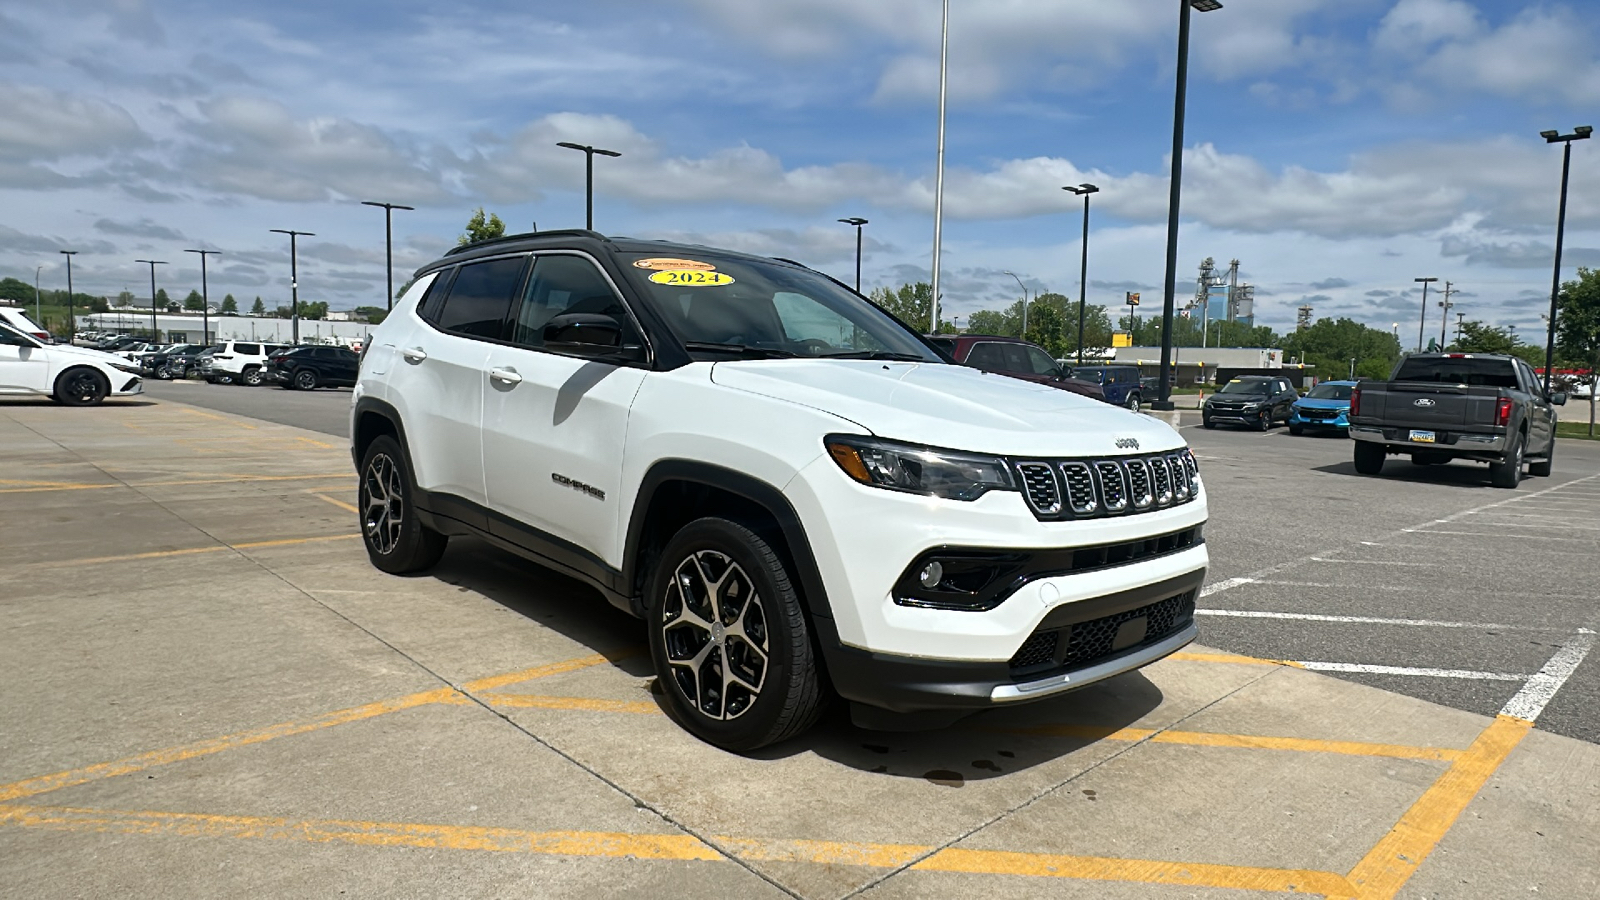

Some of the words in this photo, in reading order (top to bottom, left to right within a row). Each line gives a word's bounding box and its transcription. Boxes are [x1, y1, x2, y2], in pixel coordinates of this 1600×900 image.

[667, 273, 720, 284] 2024
[1115, 438, 1139, 450] Jeep
[551, 472, 606, 499] COMPASS
